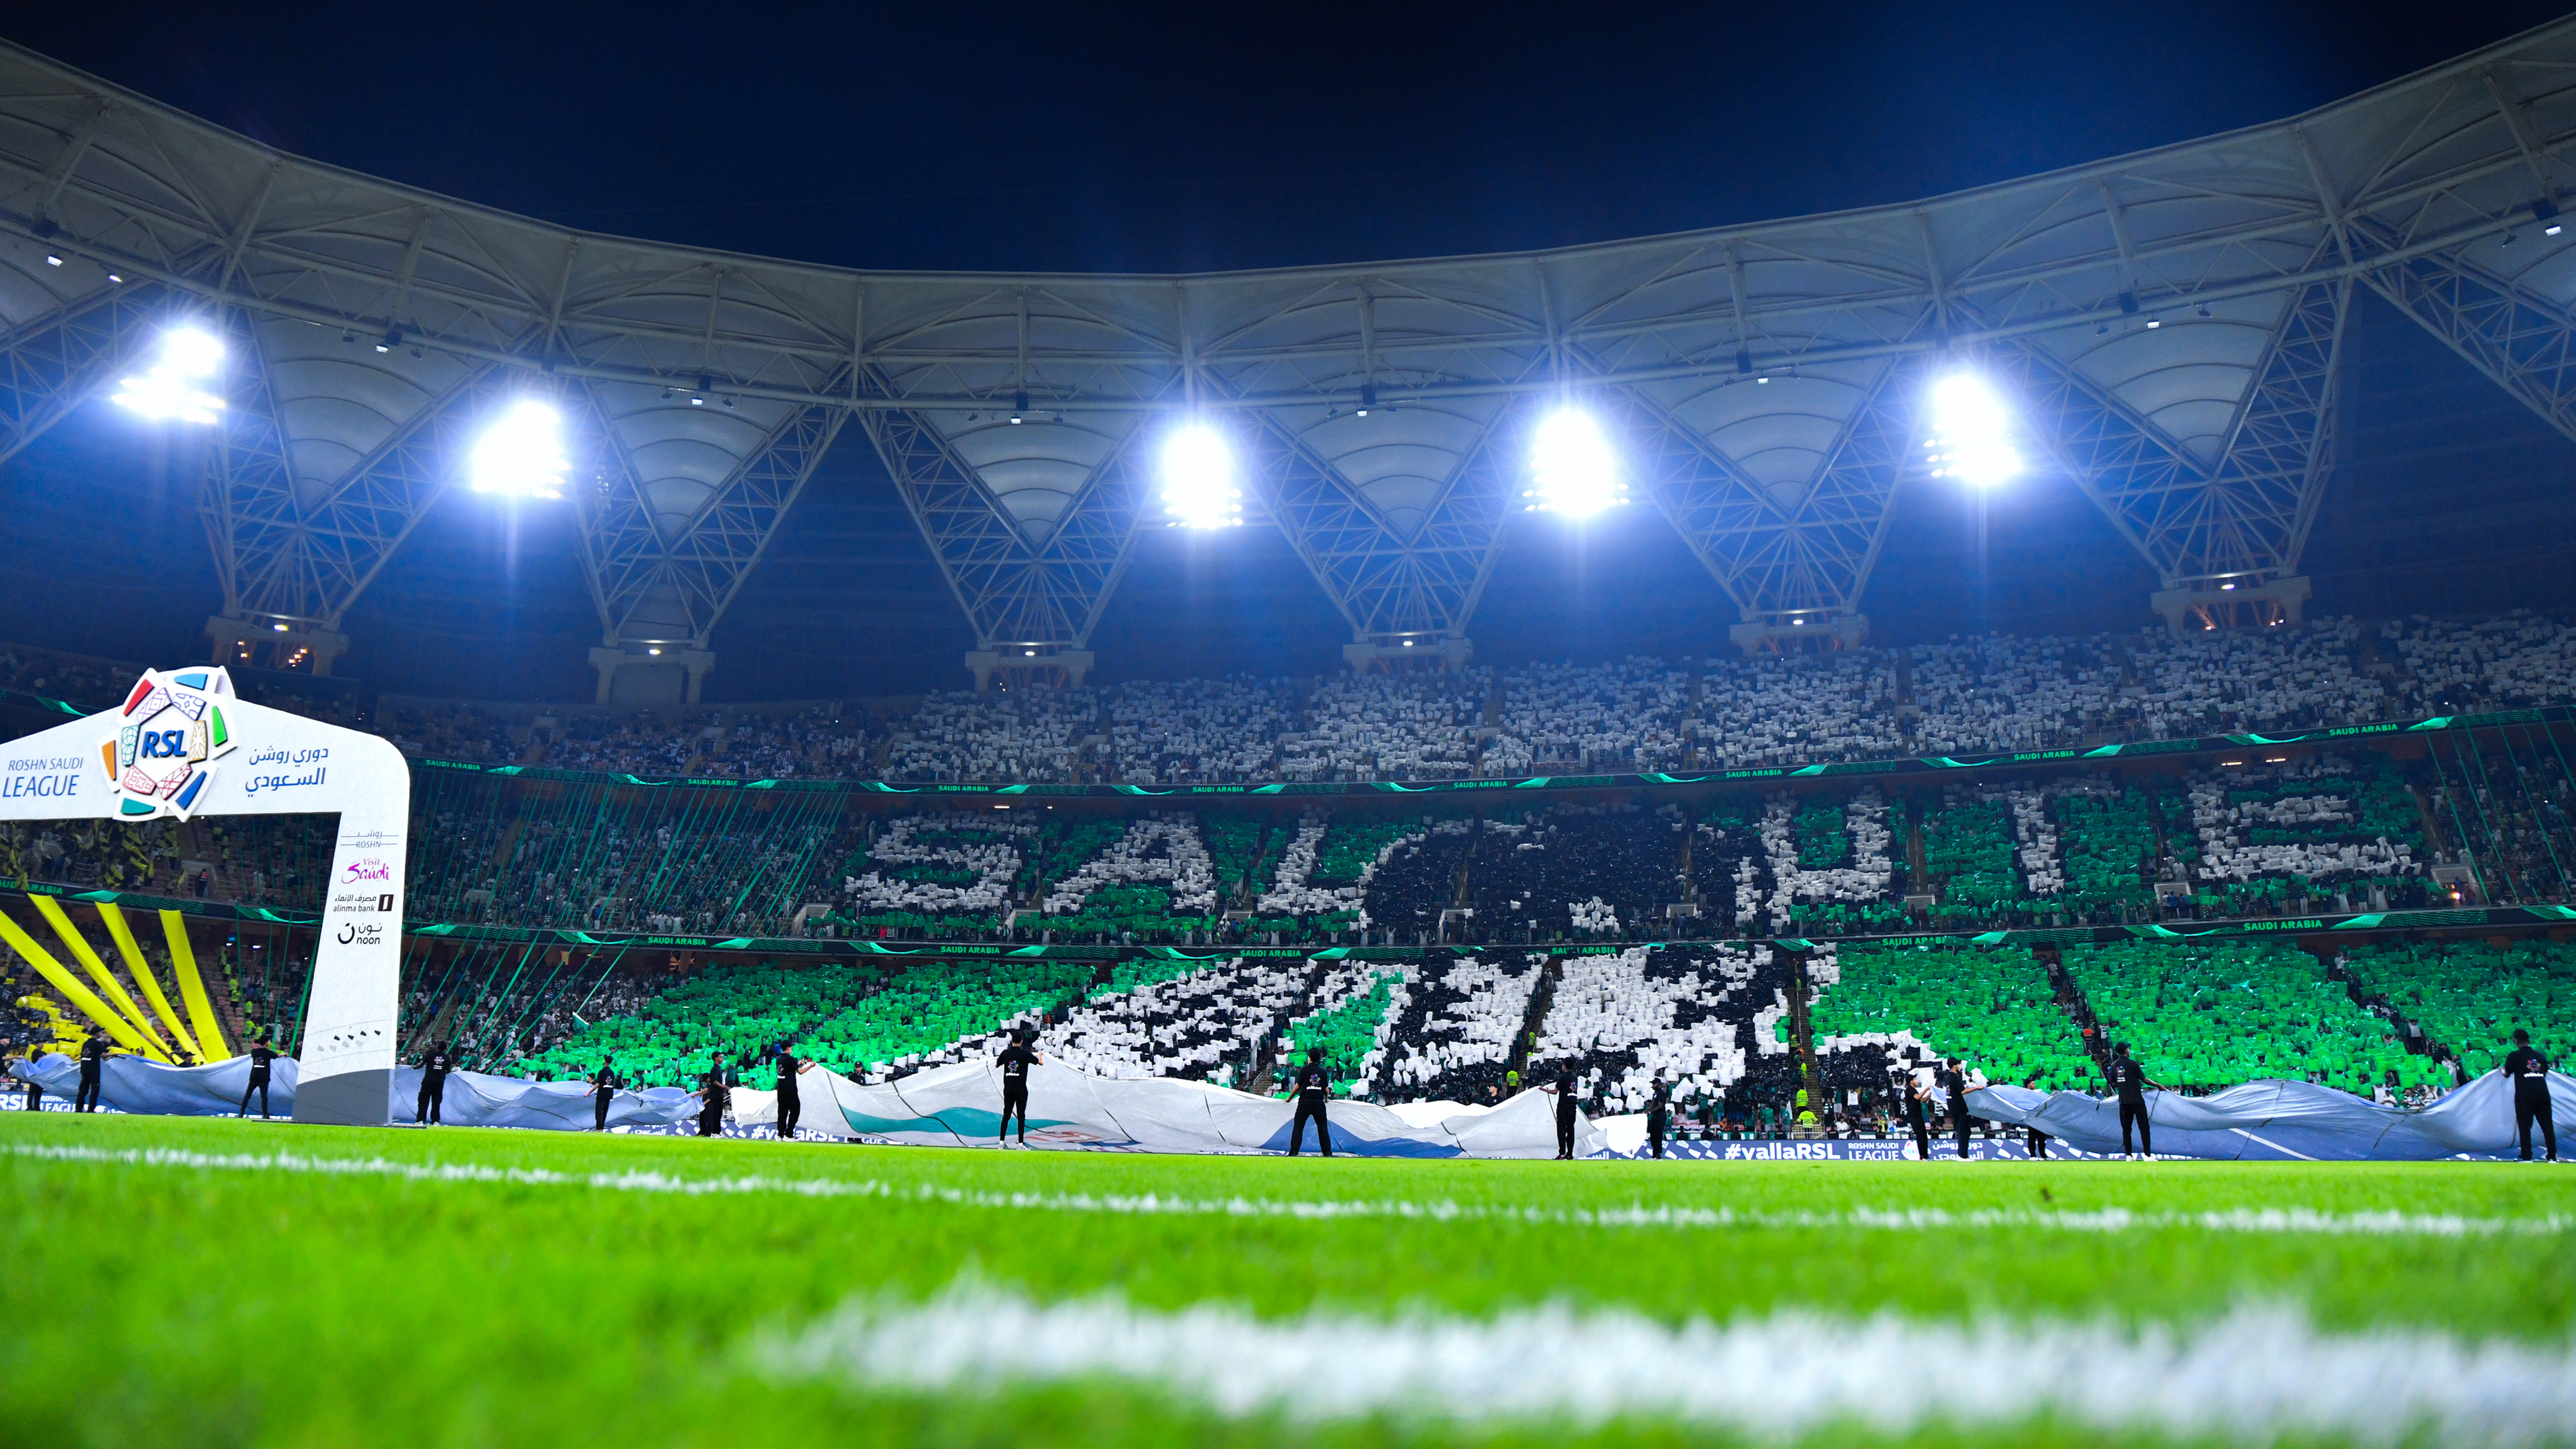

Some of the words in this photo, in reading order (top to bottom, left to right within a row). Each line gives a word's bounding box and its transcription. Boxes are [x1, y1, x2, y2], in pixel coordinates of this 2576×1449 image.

[2329, 727, 2359, 736] SAUDI
[2361, 724, 2398, 733] ARABIA
[141, 729, 187, 758] RSL
[249, 745, 290, 766] روشن
[293, 748, 329, 767] دوري
[2042, 750, 2075, 758] ARABIA
[8, 758, 48, 771] ROSHN
[49, 757, 83, 770] SAUDI
[426, 759, 450, 767] SAUDI
[451, 762, 480, 770] ARABIA
[2, 775, 79, 797] LEAGUE
[245, 767, 326, 797] السعودي
[363, 857, 380, 866] Visit
[341, 862, 389, 884] Saudi
[355, 894, 377, 903] مصرف
[358, 922, 382, 936] نون
[2243, 922, 2277, 931] SAUDI
[2281, 919, 2323, 929] ARABIA
[1883, 938, 1912, 946] SAUDI
[1849, 1151, 1899, 1161] LEAGUE
